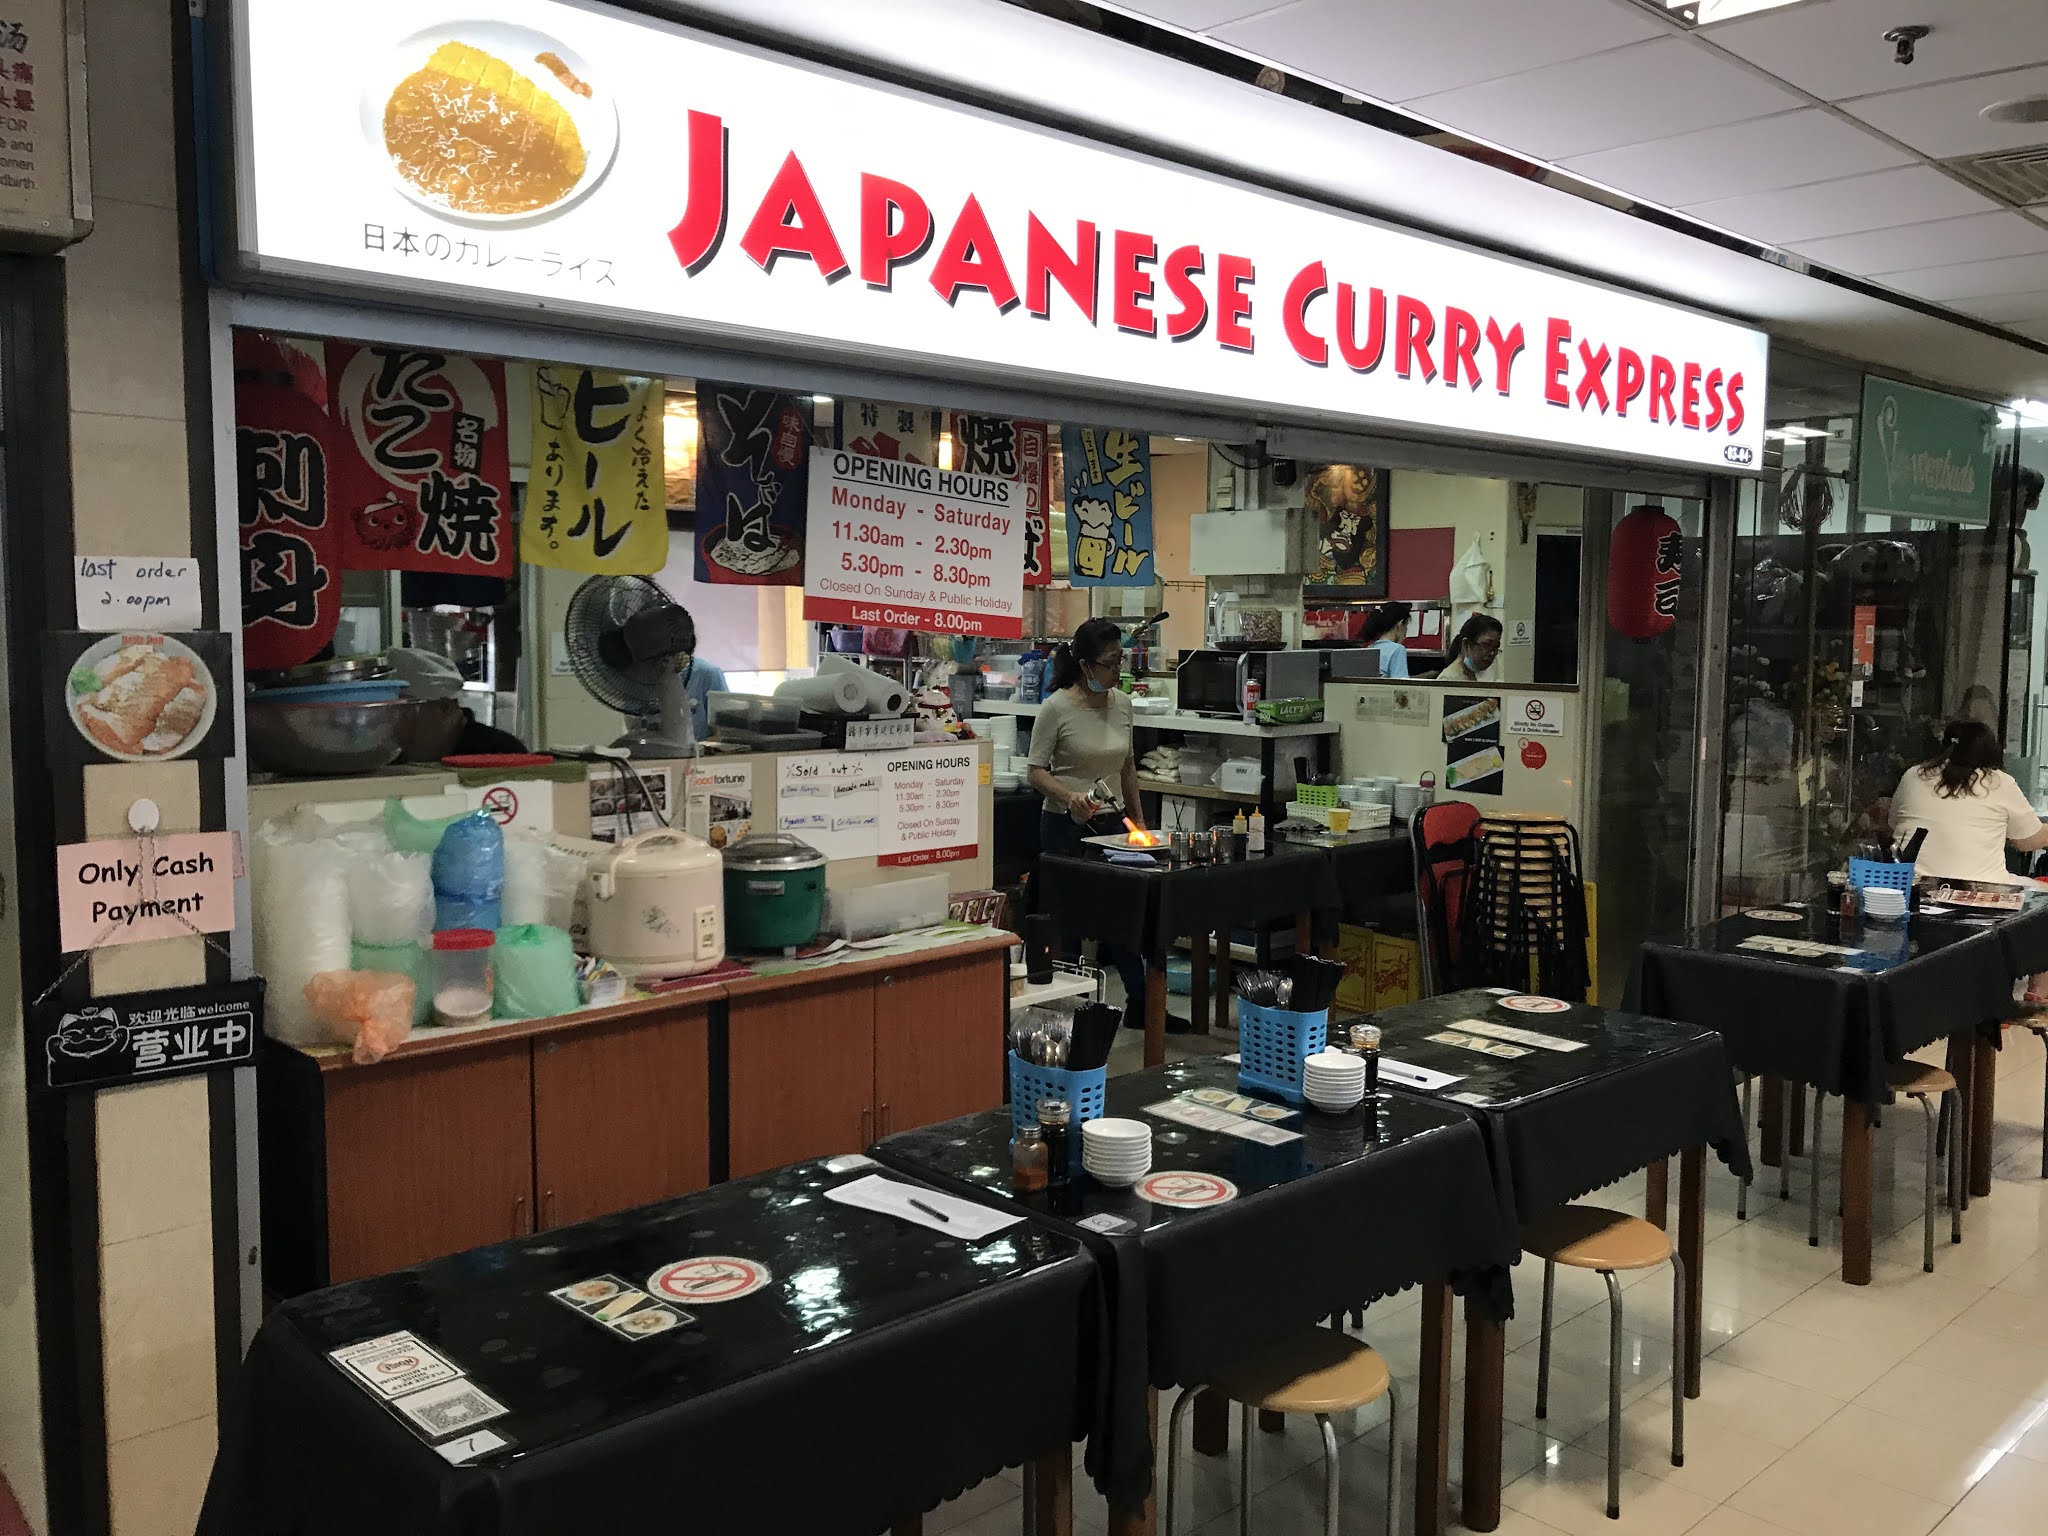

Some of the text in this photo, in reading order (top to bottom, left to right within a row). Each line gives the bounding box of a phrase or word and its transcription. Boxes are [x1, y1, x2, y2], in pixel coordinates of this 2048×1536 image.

[364, 223, 616, 286] 日本のカレーライス
[667, 108, 1746, 437] JAPANESE CURRY EXPRESS
[833, 453, 1009, 502] OPENING HOURS
[831, 486, 907, 520] Monday
[934, 503, 1011, 536] Saturday
[832, 520, 904, 548] 11.30am
[934, 535, 992, 560] 2.30pm
[80, 557, 187, 580] last order
[841, 552, 904, 578] 5.30pm
[933, 564, 991, 588] 8.30pm
[819, 577, 1013, 612] Closed On Sunday & Public Holiday
[851, 605, 881, 622] Last
[883, 609, 921, 626] Order
[933, 612, 982, 632] 8.00pm
[795, 763, 848, 777] Sold out
[887, 757, 970, 772] OPENING HOURS
[714, 774, 745, 784] fortune
[894, 779, 924, 790] Monday
[934, 776, 965, 788] Saturday
[896, 791, 924, 801] 11.30am
[935, 789, 960, 799] 2.30pm
[899, 802, 924, 812] 5.30pm
[935, 800, 960, 811] 8.30pm
[897, 816, 961, 831] Closed On Sunday
[901, 828, 957, 841] & Public Holiday
[898, 855, 912, 864] Last
[913, 853, 929, 863] Order
[935, 850, 960, 860] 8.00pm
[78, 852, 214, 887] Only Cash
[92, 892, 204, 925] Payment
[128, 1004, 196, 1026] 欢迎光临
[197, 1001, 250, 1016] welcome
[132, 1019, 247, 1069] 营业中
[455, 1438, 475, 1452] 7
